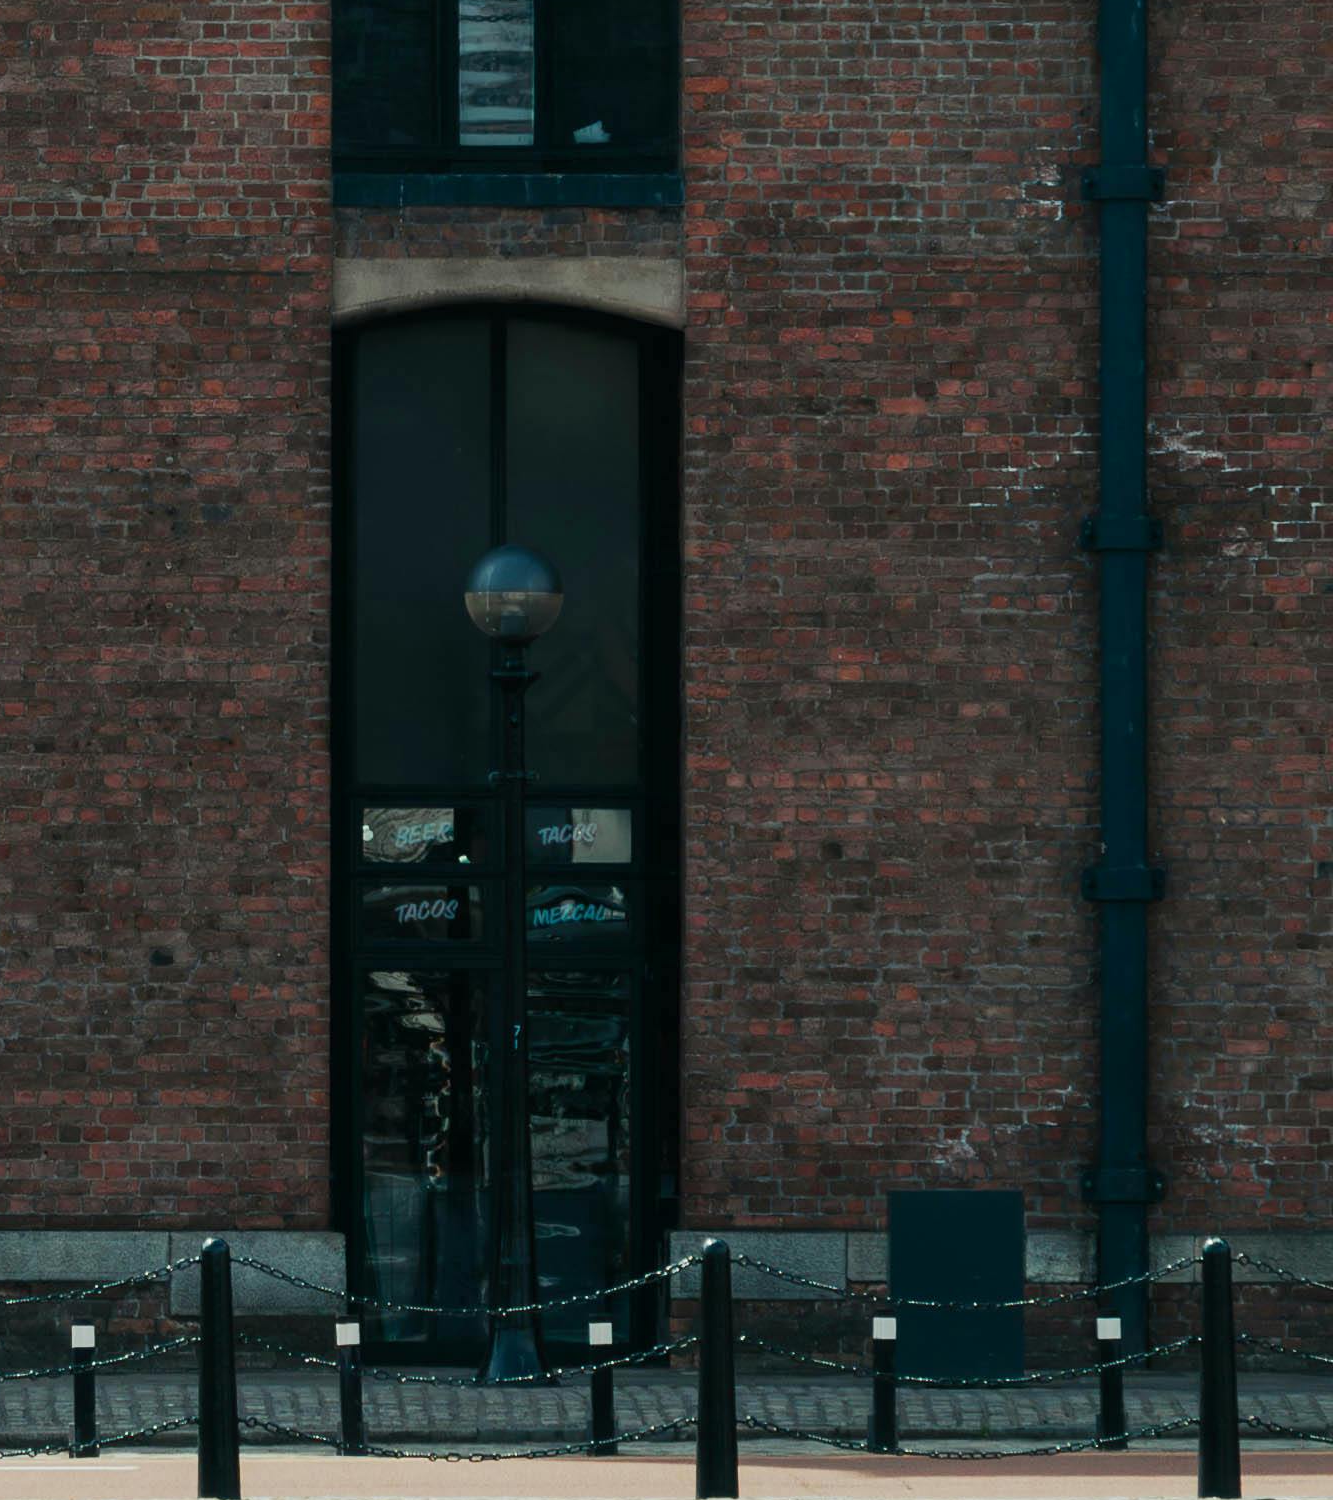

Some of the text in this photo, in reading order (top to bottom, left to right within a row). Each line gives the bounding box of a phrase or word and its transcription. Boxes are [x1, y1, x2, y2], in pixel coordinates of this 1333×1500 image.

[394, 823, 453, 847] BEER
[538, 822, 598, 846] TACOS
[395, 898, 460, 923] TACOS
[532, 903, 607, 927] MEZCAL
